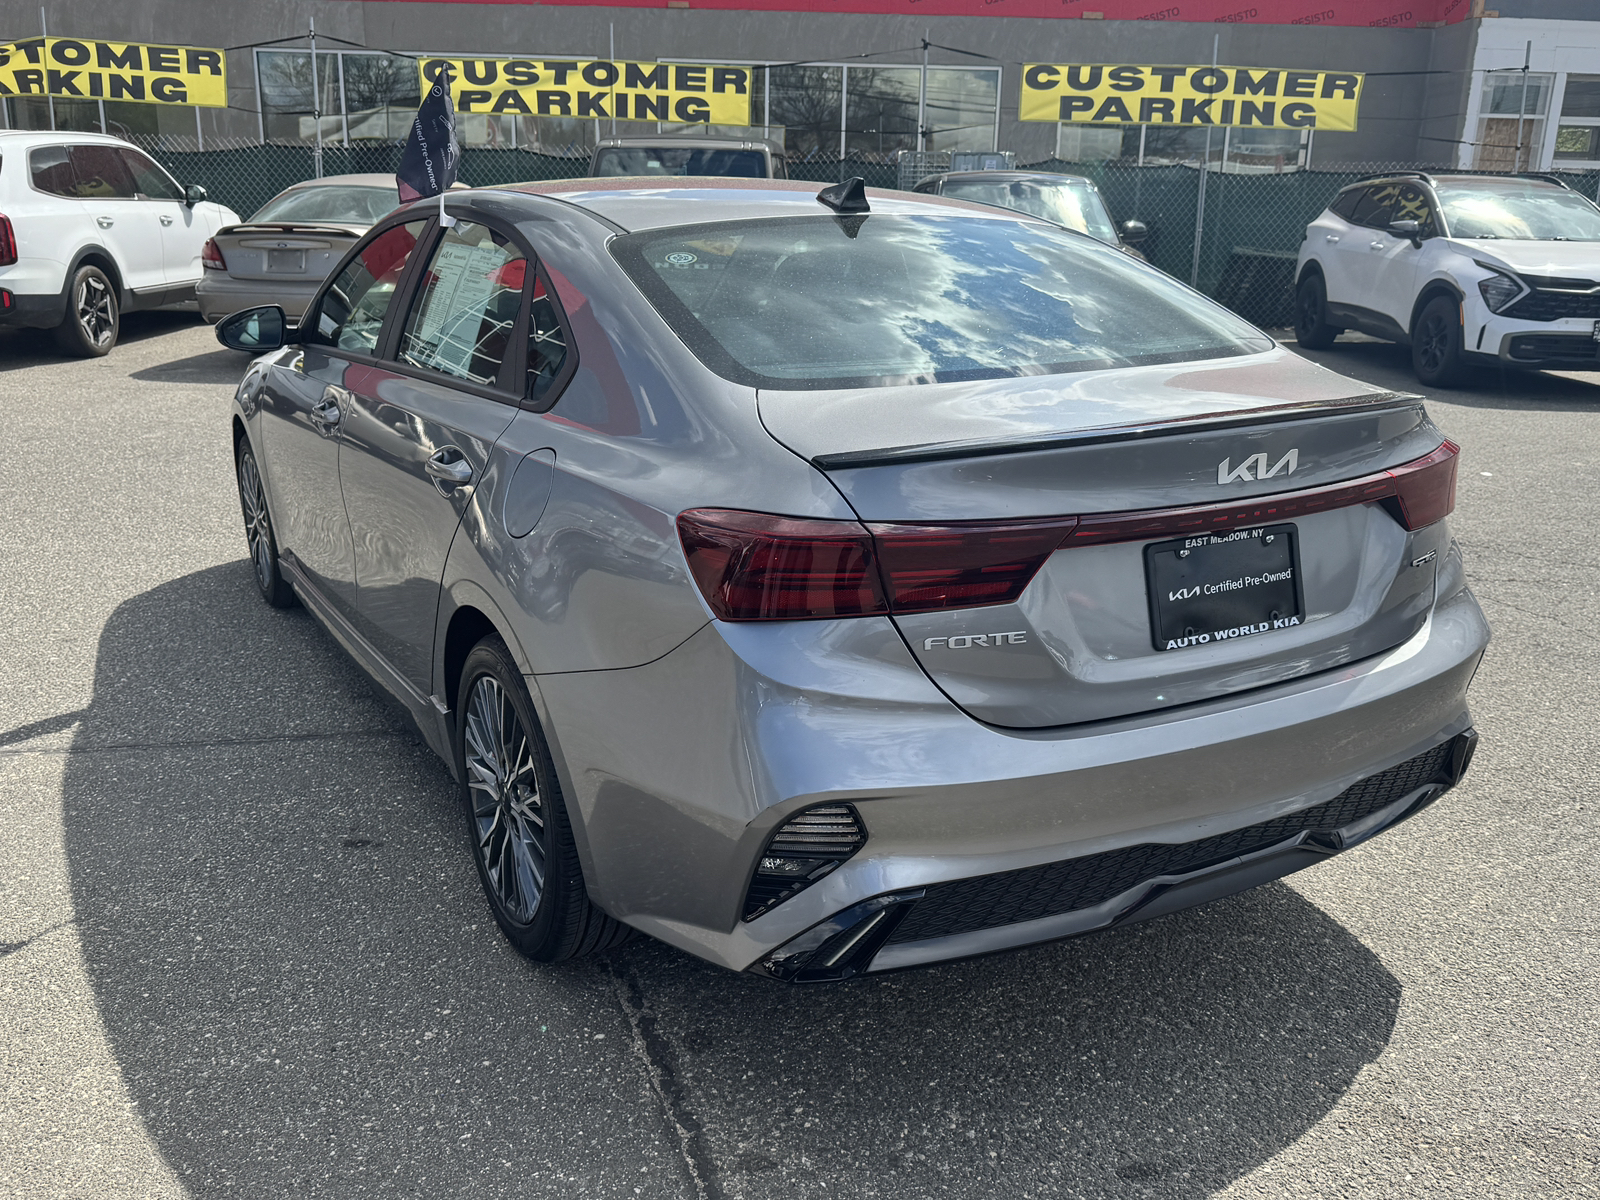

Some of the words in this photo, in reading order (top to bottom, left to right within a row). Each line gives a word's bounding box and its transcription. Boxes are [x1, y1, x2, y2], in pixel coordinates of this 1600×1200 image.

[0, 38, 222, 76] TOMER
[423, 59, 748, 95] CUSTOMER
[1025, 65, 1359, 100] CUSTOMER
[458, 89, 710, 123] PARKING
[1059, 95, 1317, 128] PARKING
[1217, 448, 1299, 485] KIA
[1185, 536, 1208, 548] EAST
[1252, 528, 1264, 538] NY
[1168, 585, 1201, 602] KIA
[1203, 578, 1243, 595] Certified
[923, 630, 1027, 651] FORTE
[1166, 633, 1210, 650] AUTO
[1214, 621, 1269, 641] WORLD
[1273, 616, 1300, 629] KIA
